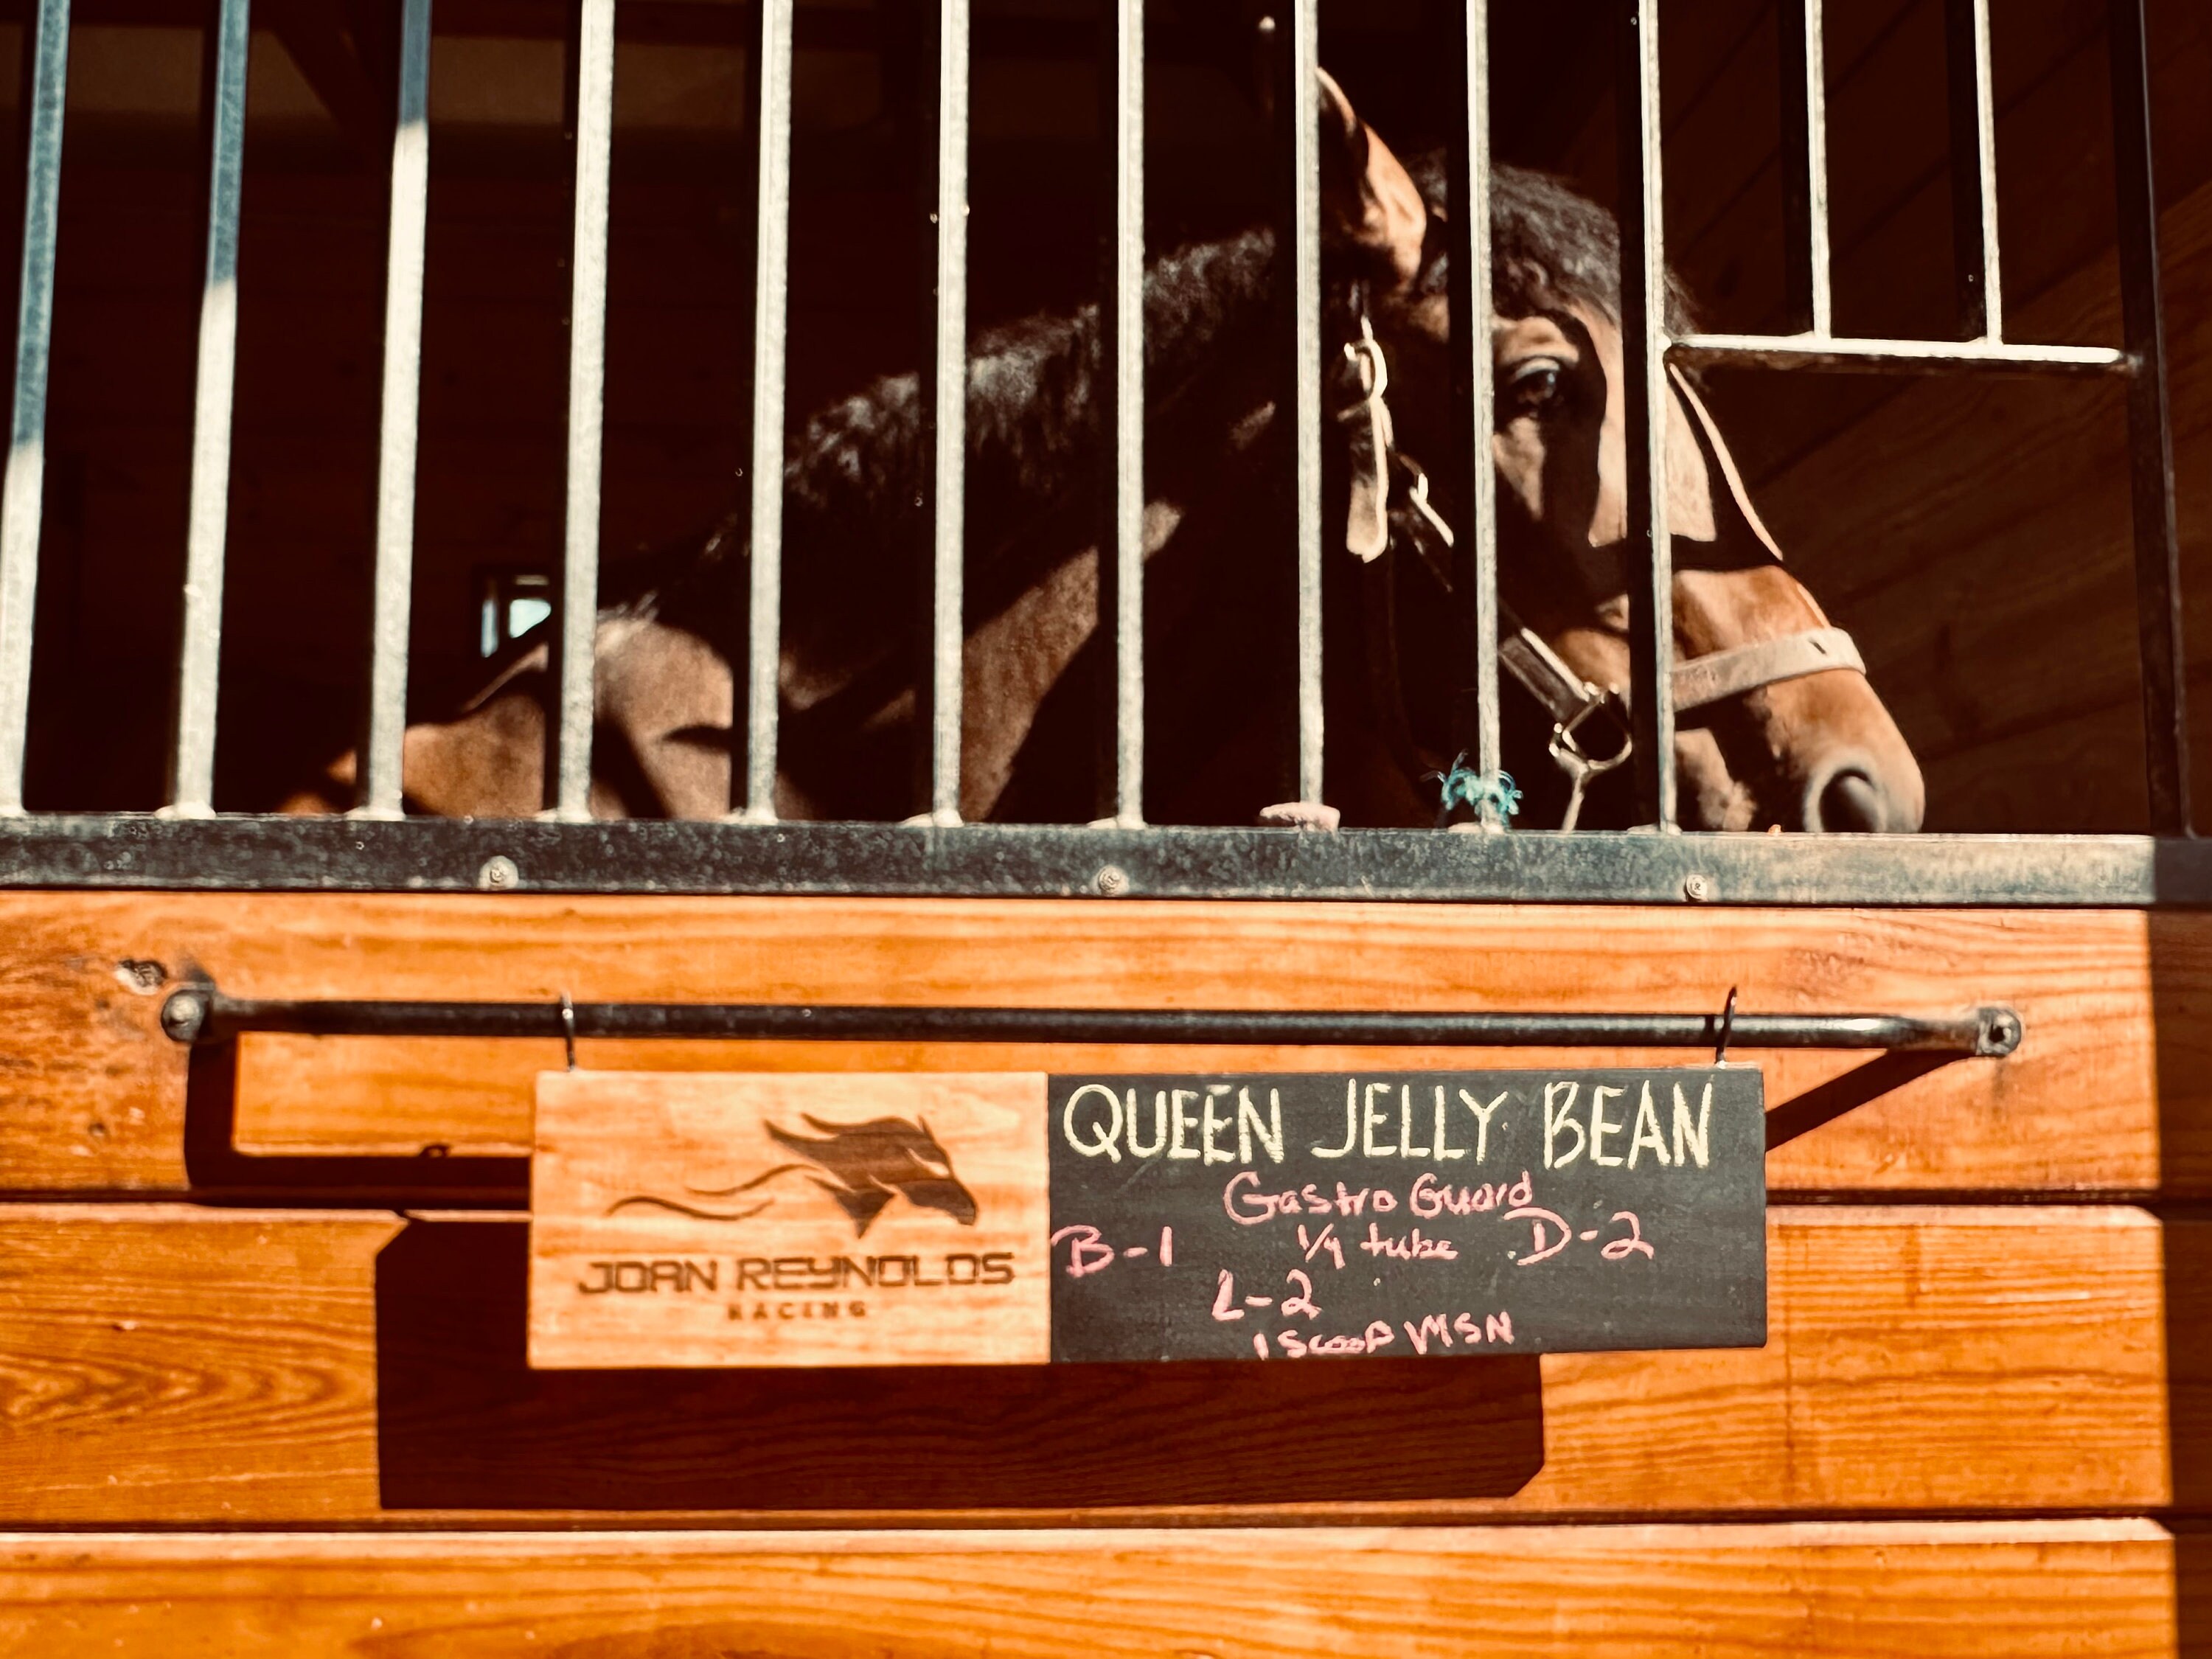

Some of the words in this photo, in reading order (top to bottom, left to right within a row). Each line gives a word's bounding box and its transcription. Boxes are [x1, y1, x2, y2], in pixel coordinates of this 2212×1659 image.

[1063, 1083, 1284, 1166] QUEEN
[1310, 1077, 1509, 1165] JELLY
[1544, 1077, 1713, 1169] BEAN
[1222, 1170, 1399, 1225] Gastro
[1409, 1169, 1534, 1220] Guard
[1297, 1222, 1346, 1270] 1/4
[1360, 1221, 1459, 1261] tube
[578, 1259, 718, 1295] JOAN
[737, 1251, 1015, 1290] REYNOLDS
[727, 1300, 867, 1321] RACING
